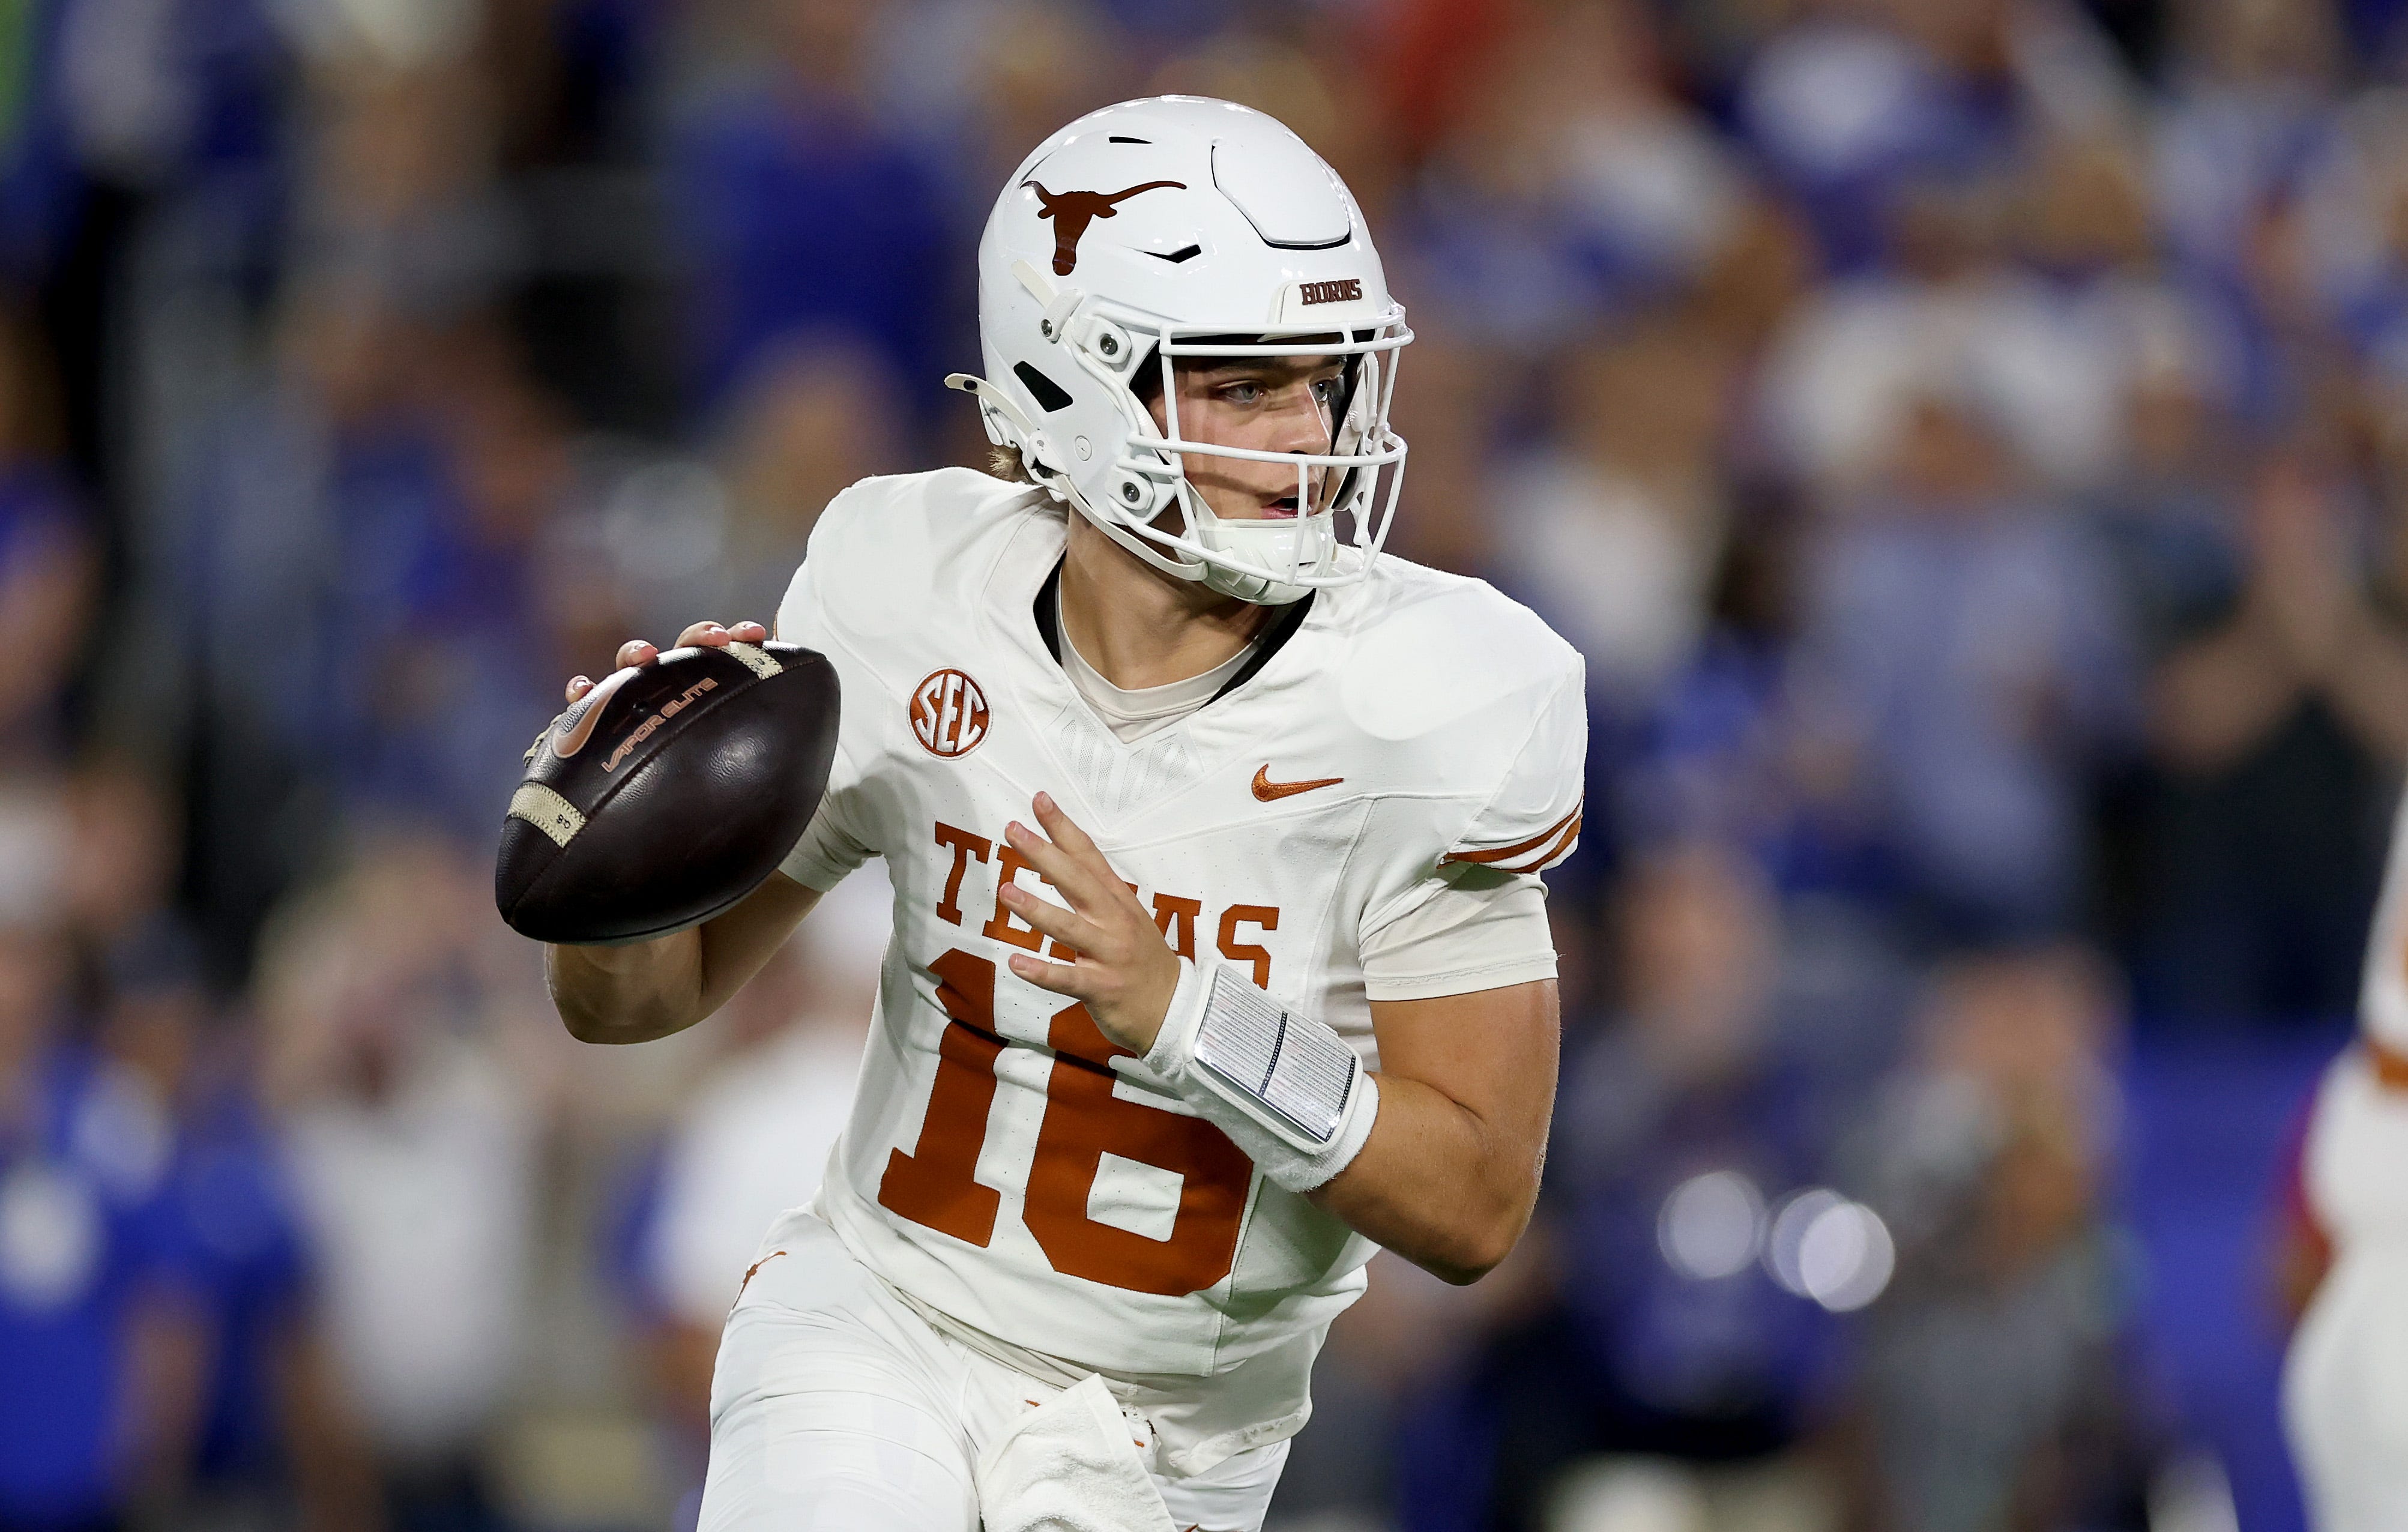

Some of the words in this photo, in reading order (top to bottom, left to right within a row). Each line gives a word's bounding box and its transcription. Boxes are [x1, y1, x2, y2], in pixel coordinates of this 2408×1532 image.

[1299, 279, 1363, 306] HORNS
[601, 714, 666, 773] VAPOR
[660, 677, 719, 719] ELITE
[915, 672, 986, 753] SEC
[935, 820, 1280, 991] TEAS
[878, 947, 1255, 1297] 16
